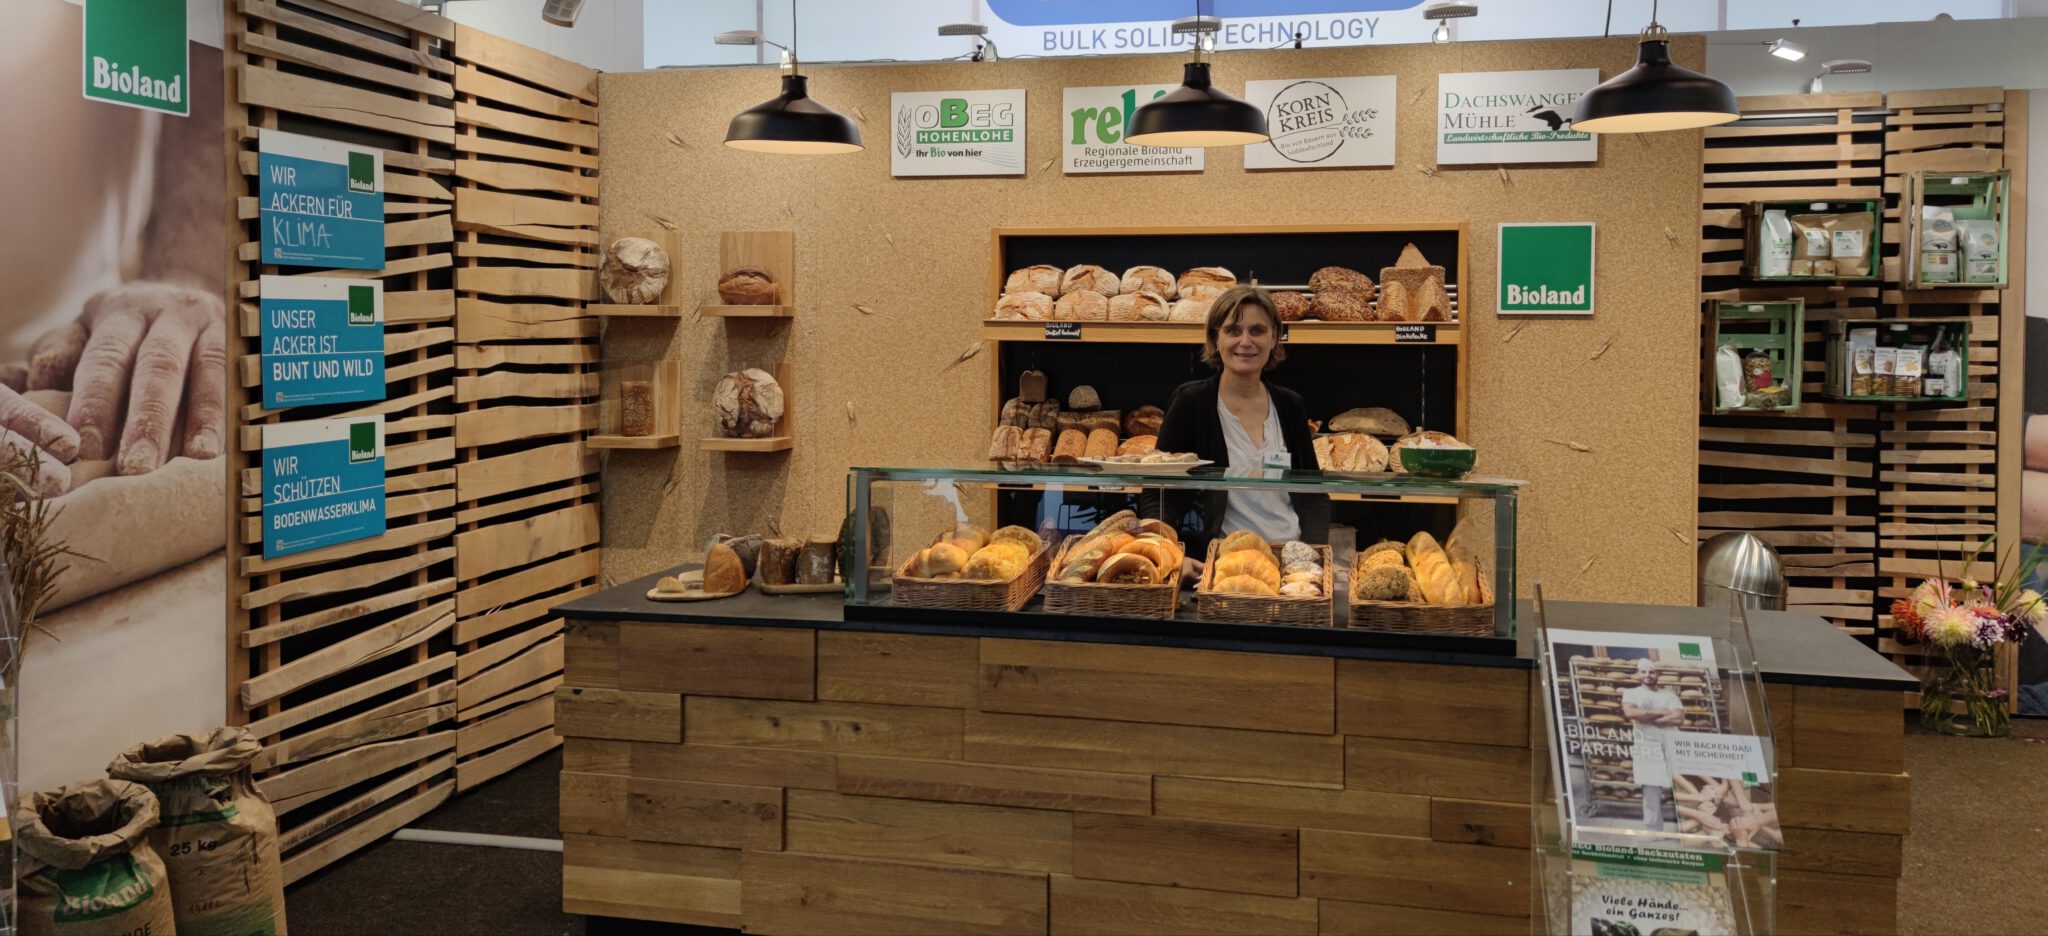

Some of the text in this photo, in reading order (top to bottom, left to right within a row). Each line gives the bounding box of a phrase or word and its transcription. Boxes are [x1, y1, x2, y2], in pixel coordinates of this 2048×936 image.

[1043, 29, 1106, 50] BULK
[1206, 17, 1380, 45] ECHNOLOGY
[93, 56, 182, 103] Bioland
[1276, 93, 1331, 117] KORN
[1280, 108, 1334, 132] KREIS
[1444, 112, 1516, 129] MÜHLE
[919, 130, 1010, 142] HOHENLOHE
[1446, 131, 1589, 143] Landwirtschaftliche Bio-Produkte
[930, 147, 946, 157] Bio
[965, 149, 983, 157] hier
[1084, 145, 1183, 158] Regionale Bioland
[1073, 155, 1193, 168] Erzeugergemeinschaft
[270, 164, 296, 187] WIR
[351, 178, 374, 191] Bioland
[271, 191, 353, 218] ACKERN FÜR
[1507, 284, 1585, 305] Bioland
[271, 310, 316, 329] UNSER
[350, 312, 374, 323] Bioland
[272, 335, 338, 355] ACKER IST
[273, 358, 374, 381] BUNT UND WILD
[351, 448, 375, 461] Bioland
[273, 456, 298, 477] WIR
[273, 475, 341, 504] SCHÜTZEN
[273, 497, 377, 530] BODENWASSERKLIMA
[1570, 741, 1664, 761] PARTNERS
[1674, 740, 1691, 748] WIR
[1694, 741, 1729, 751] BACKEN
[1676, 749, 1745, 761] MIT SICHERHEIT
[170, 842, 191, 857] 25
[1602, 894, 1633, 907] Viele
[1606, 906, 1679, 922] ein Ganzes!
